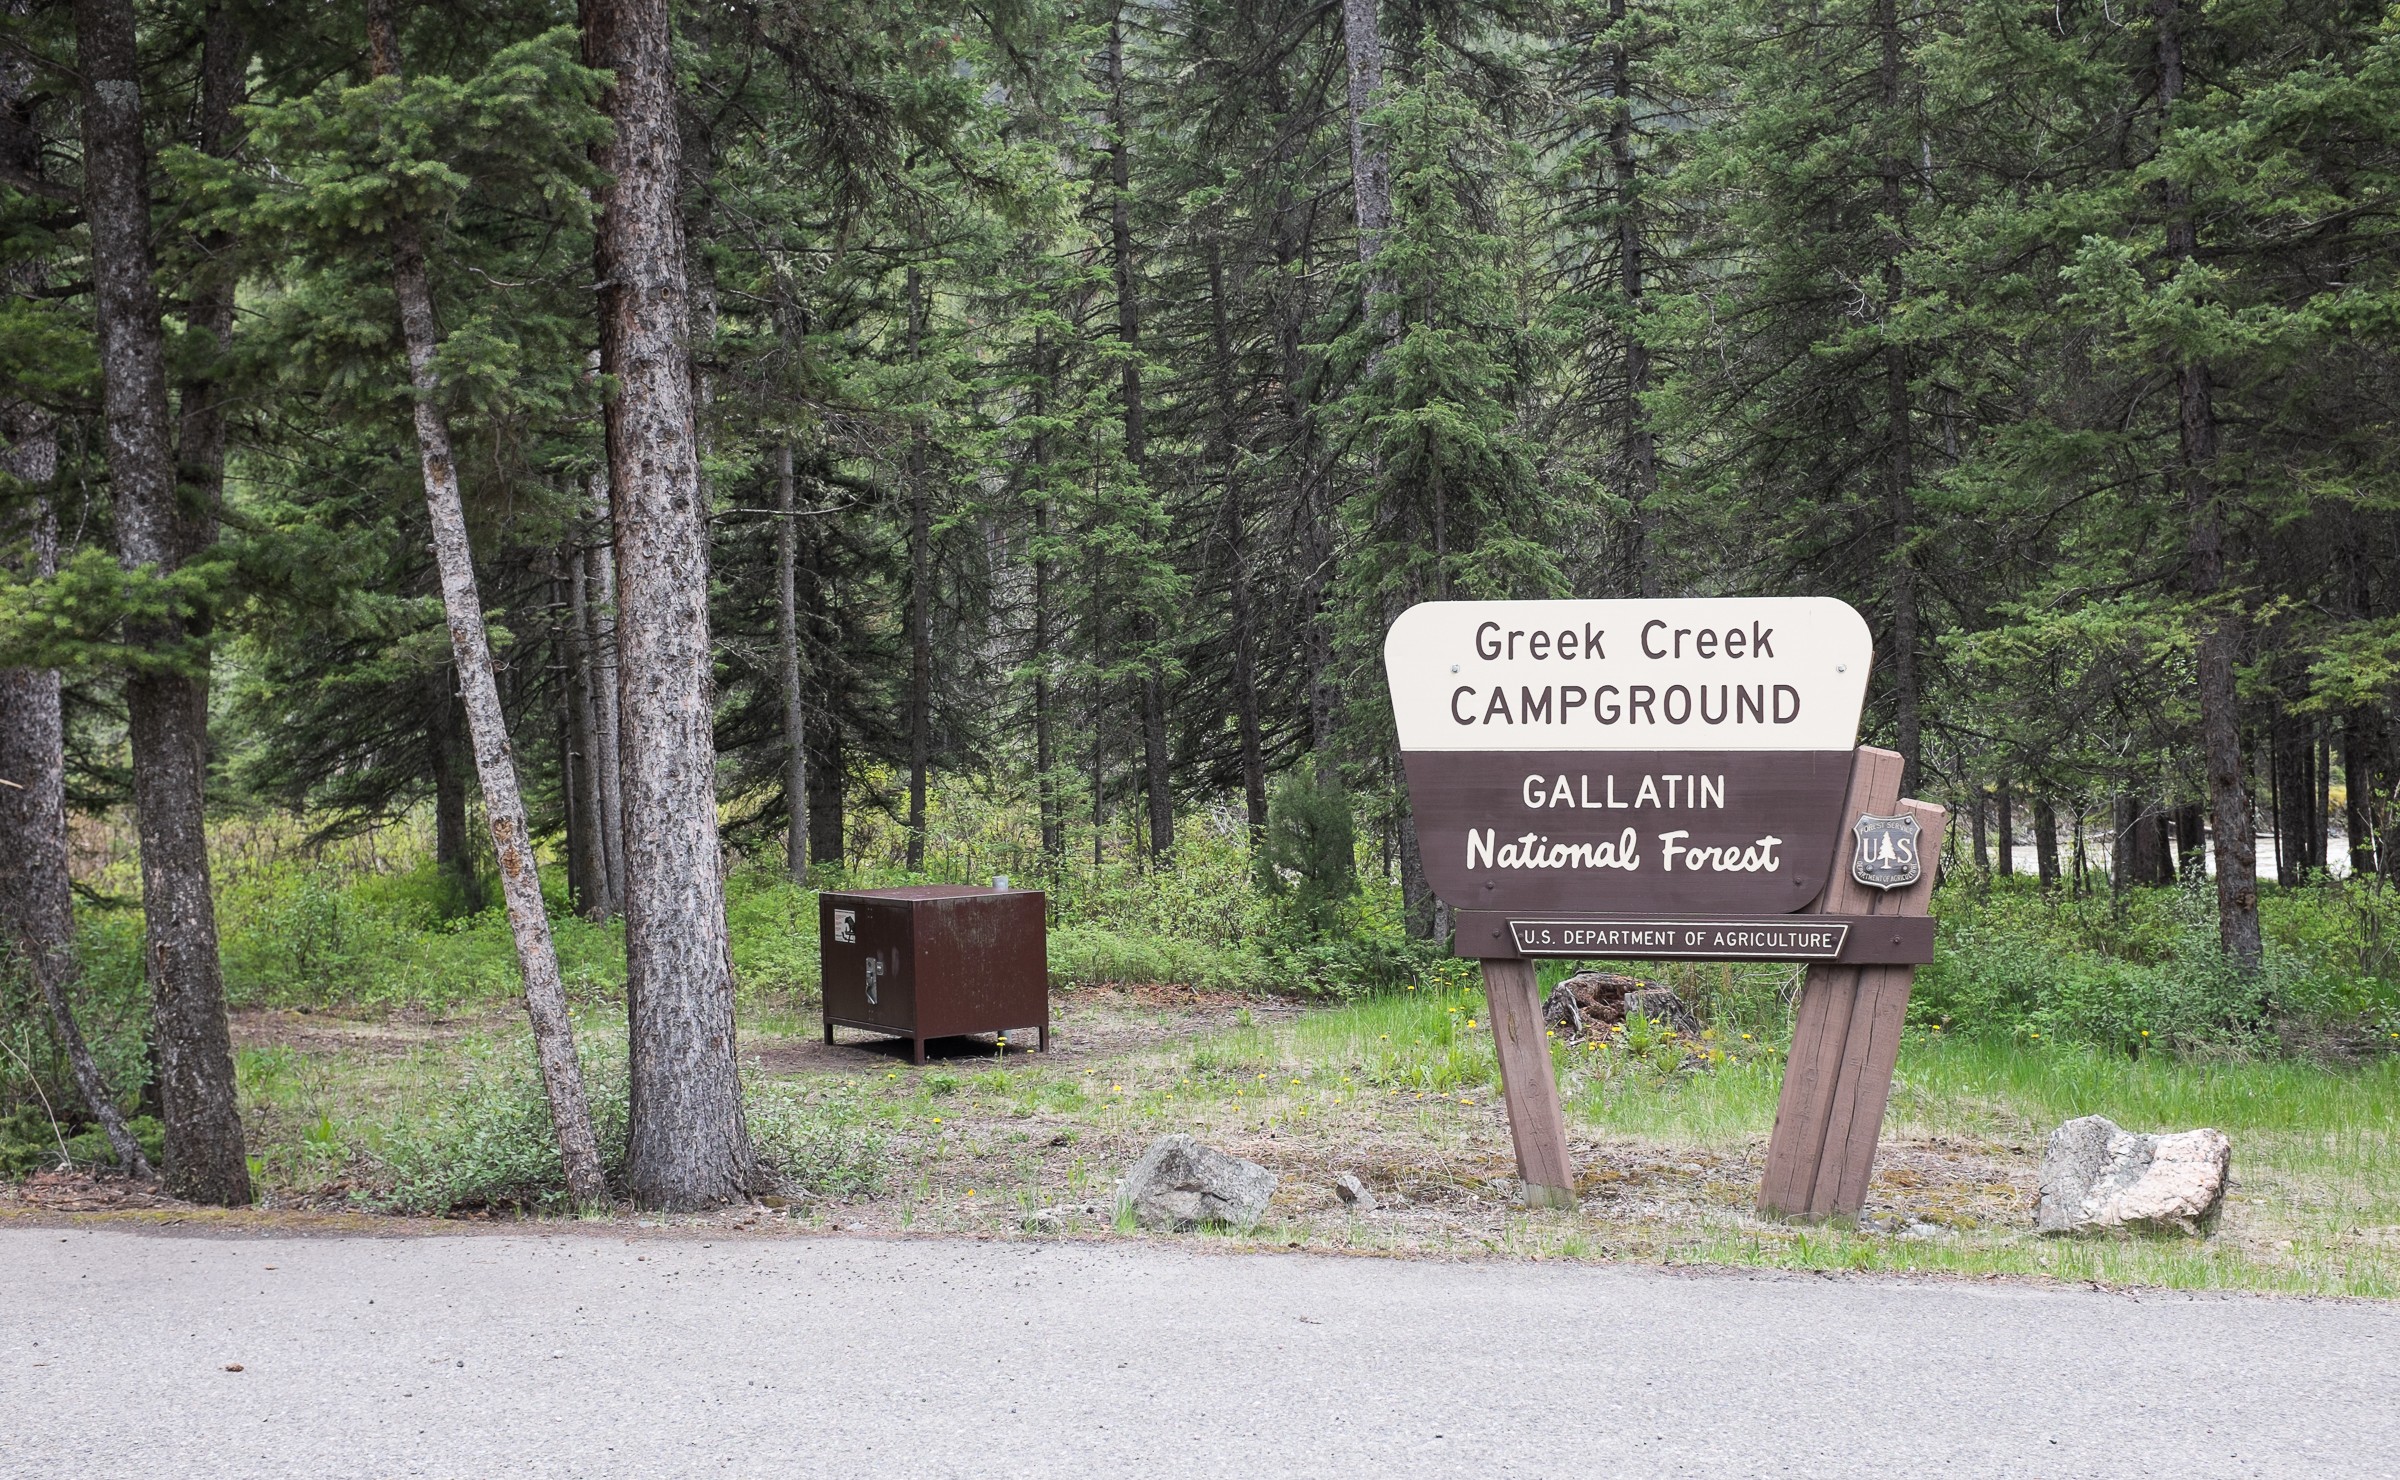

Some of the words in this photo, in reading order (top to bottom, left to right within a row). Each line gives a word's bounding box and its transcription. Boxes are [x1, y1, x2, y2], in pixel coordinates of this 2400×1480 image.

[1476, 621, 1606, 661] Greek
[1641, 619, 1775, 659] Creek
[1451, 684, 1801, 726] CAMPGROUND
[1522, 774, 1726, 809] GALLATIN
[1860, 822, 1885, 835] FOREST
[1887, 821, 1913, 835] SERVICE
[1466, 827, 1640, 871] National
[1658, 829, 1782, 873] Forest
[1524, 930, 1556, 945] U.S.
[1564, 930, 1676, 947] DEPARTMENT
[1685, 932, 1706, 947] OF
[1713, 932, 1833, 949] AGRICULTURE
